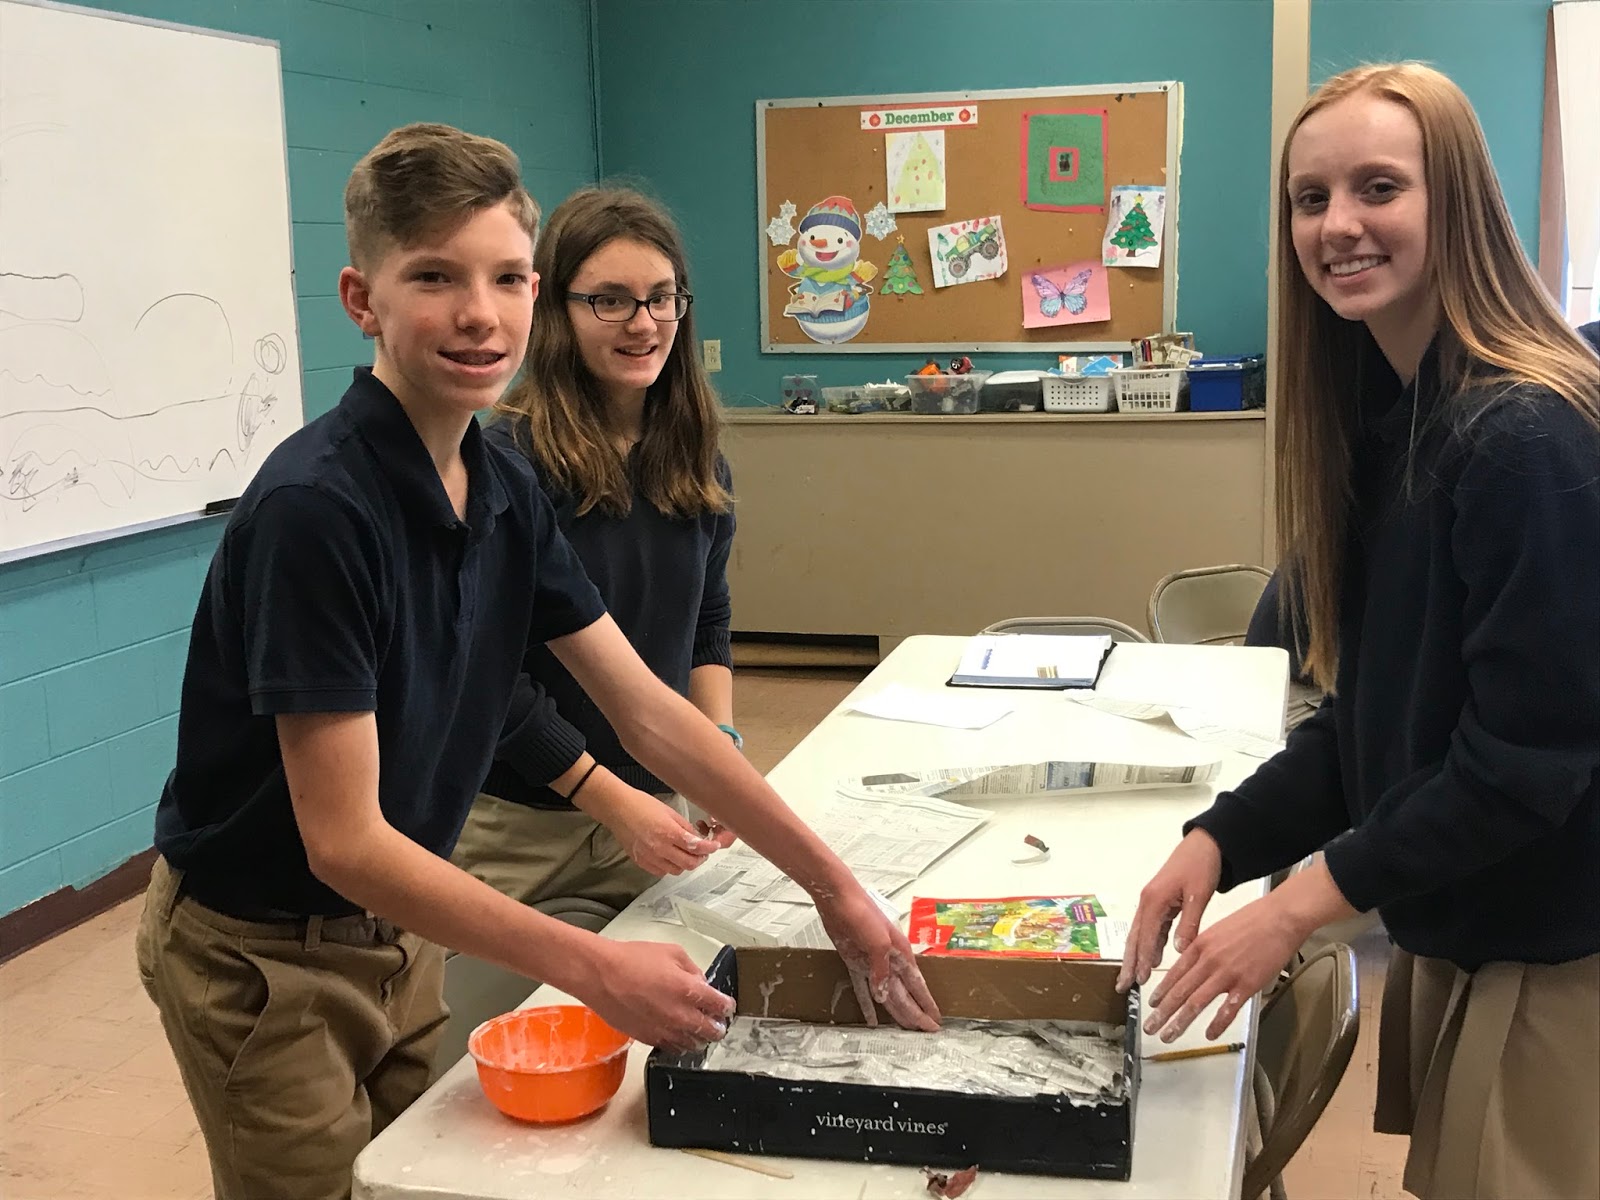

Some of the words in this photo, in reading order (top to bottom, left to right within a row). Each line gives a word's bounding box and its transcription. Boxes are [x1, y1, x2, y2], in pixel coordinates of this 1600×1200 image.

[885, 111, 954, 125] December
[816, 1112, 894, 1134] vineyard
[897, 1117, 946, 1135] vines
